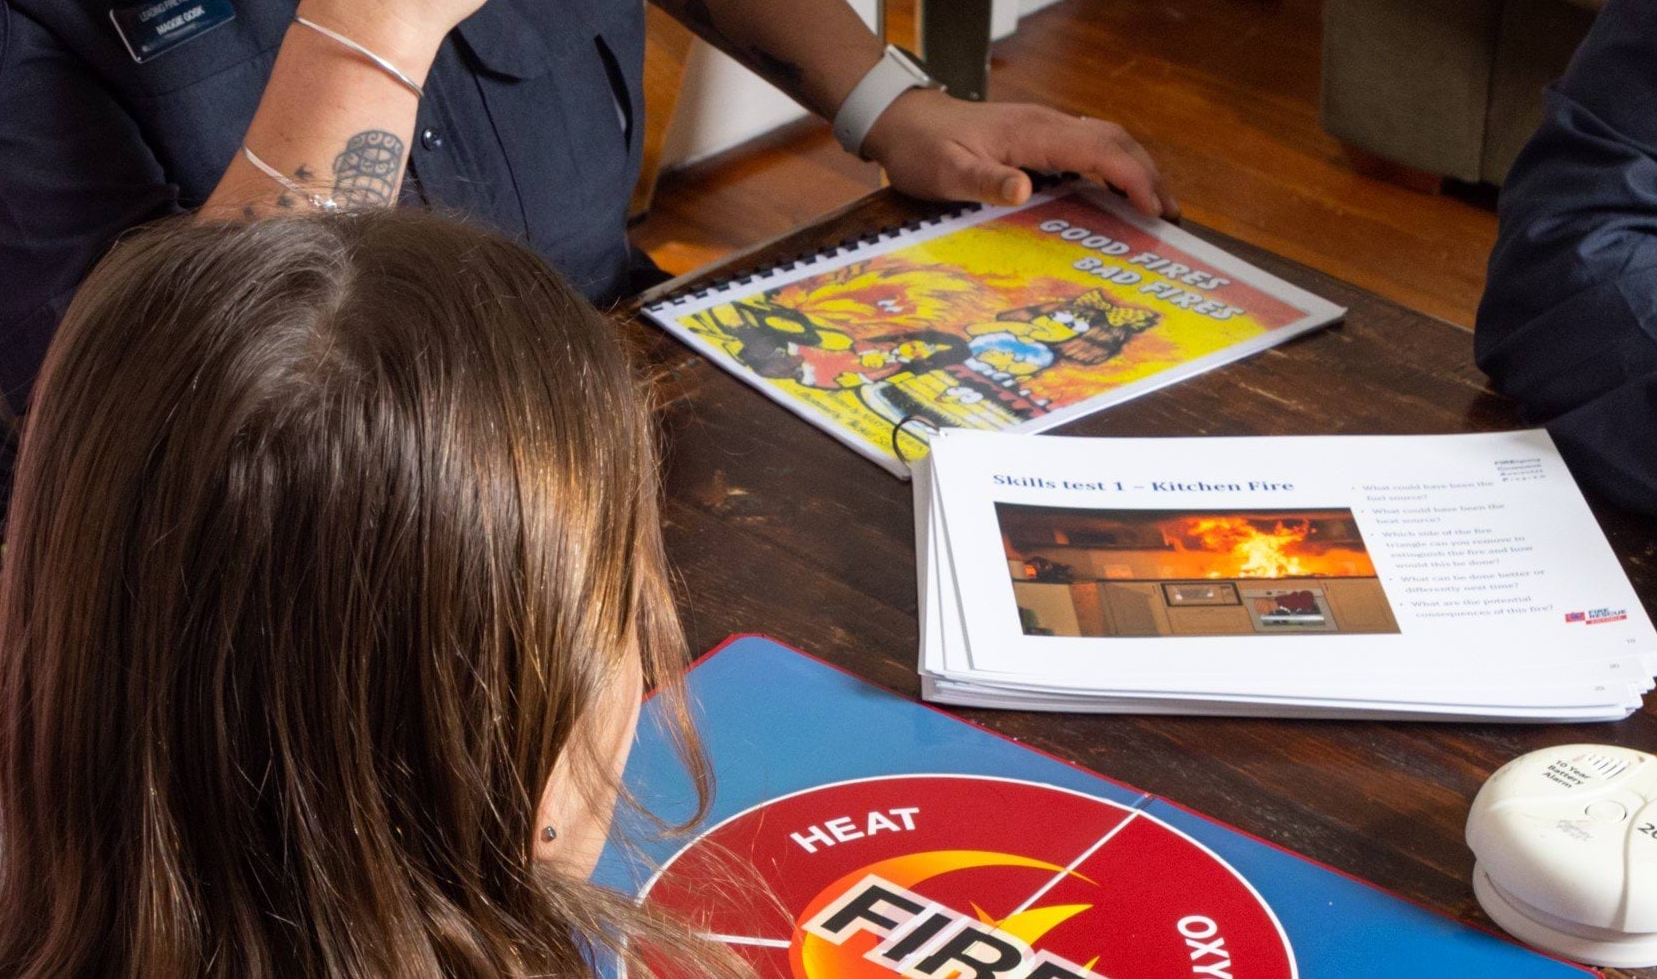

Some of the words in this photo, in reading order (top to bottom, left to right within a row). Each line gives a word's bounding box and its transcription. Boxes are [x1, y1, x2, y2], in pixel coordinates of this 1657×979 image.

[1040, 219, 1130, 255] GOOD
[1128, 252, 1230, 290] FIRES
[1073, 256, 1141, 284] BAD
[1139, 281, 1245, 320] FIRES
[993, 475, 1056, 489] Skills
[1063, 480, 1104, 491] test
[1114, 481, 1125, 491] 1
[1152, 481, 1241, 491] Kitchen
[1249, 481, 1294, 491] Fire
[1542, 772, 1572, 788] Alarm
[1548, 765, 1584, 785] Battery
[1569, 766, 1591, 779] Year
[790, 806, 922, 854] HEAT
